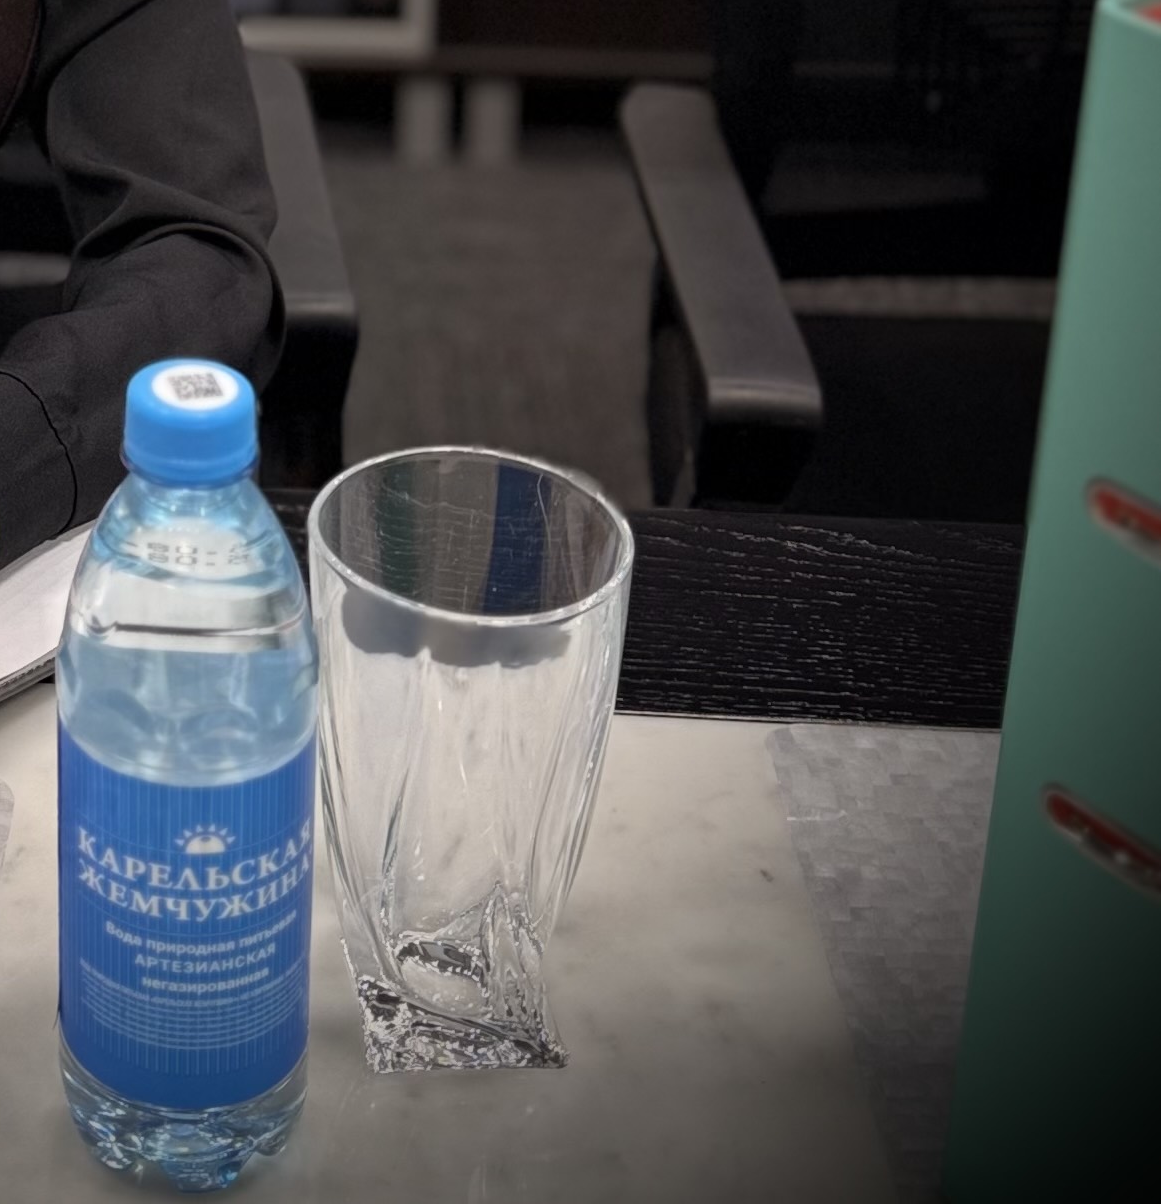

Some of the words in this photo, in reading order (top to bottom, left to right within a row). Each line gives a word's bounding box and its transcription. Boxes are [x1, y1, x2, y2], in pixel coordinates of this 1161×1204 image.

[78, 817, 312, 891] КАРЕЛЬСКАЯ
[78, 857, 310, 922] ЖЕМЧУЖИНА
[105, 920, 142, 947] Вода
[146, 938, 236, 956] природная
[135, 943, 277, 975] АРТЕЗИАНСКАЯ
[142, 967, 270, 996] негазированная
